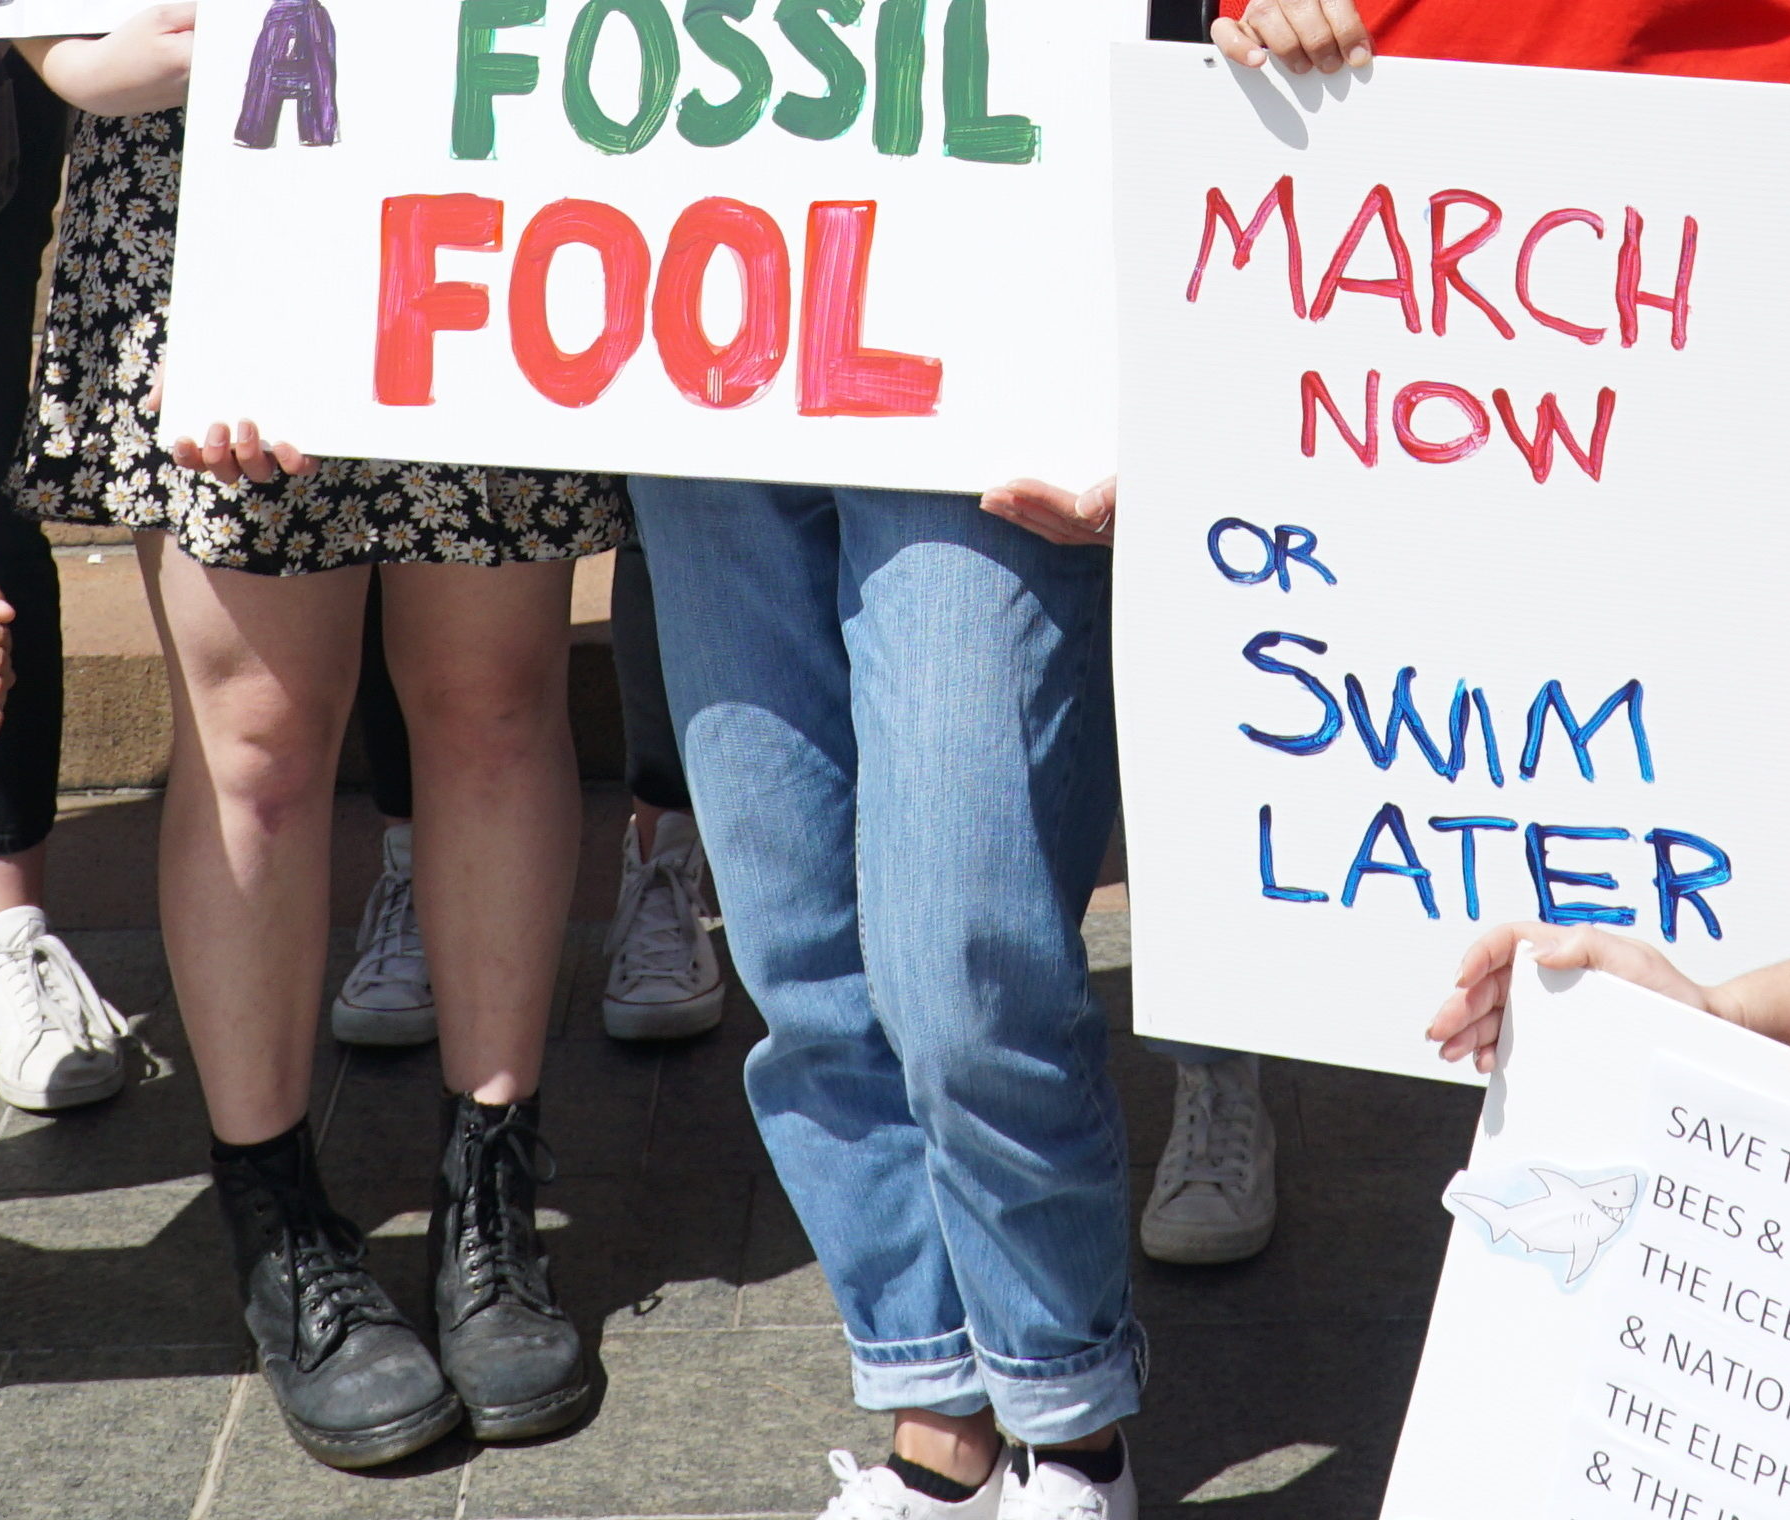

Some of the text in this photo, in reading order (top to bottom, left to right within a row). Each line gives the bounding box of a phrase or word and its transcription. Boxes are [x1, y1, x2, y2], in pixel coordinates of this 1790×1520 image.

[1186, 174, 1699, 351] MARCH
[371, 192, 943, 418] FOOL
[1300, 368, 1617, 485] NOW
[1207, 516, 1338, 593] OR
[1238, 630, 1655, 787] SWIM
[1260, 802, 1733, 944] LATER
[1665, 1105, 1768, 1173] SAVE
[1653, 1174, 1746, 1239] BEES
[1757, 1218, 1784, 1259] &
[1639, 1242, 1712, 1304] THE
[1619, 1314, 1647, 1356] &
[1606, 1382, 1678, 1445] THE
[1585, 1450, 1703, 1520] & THE
